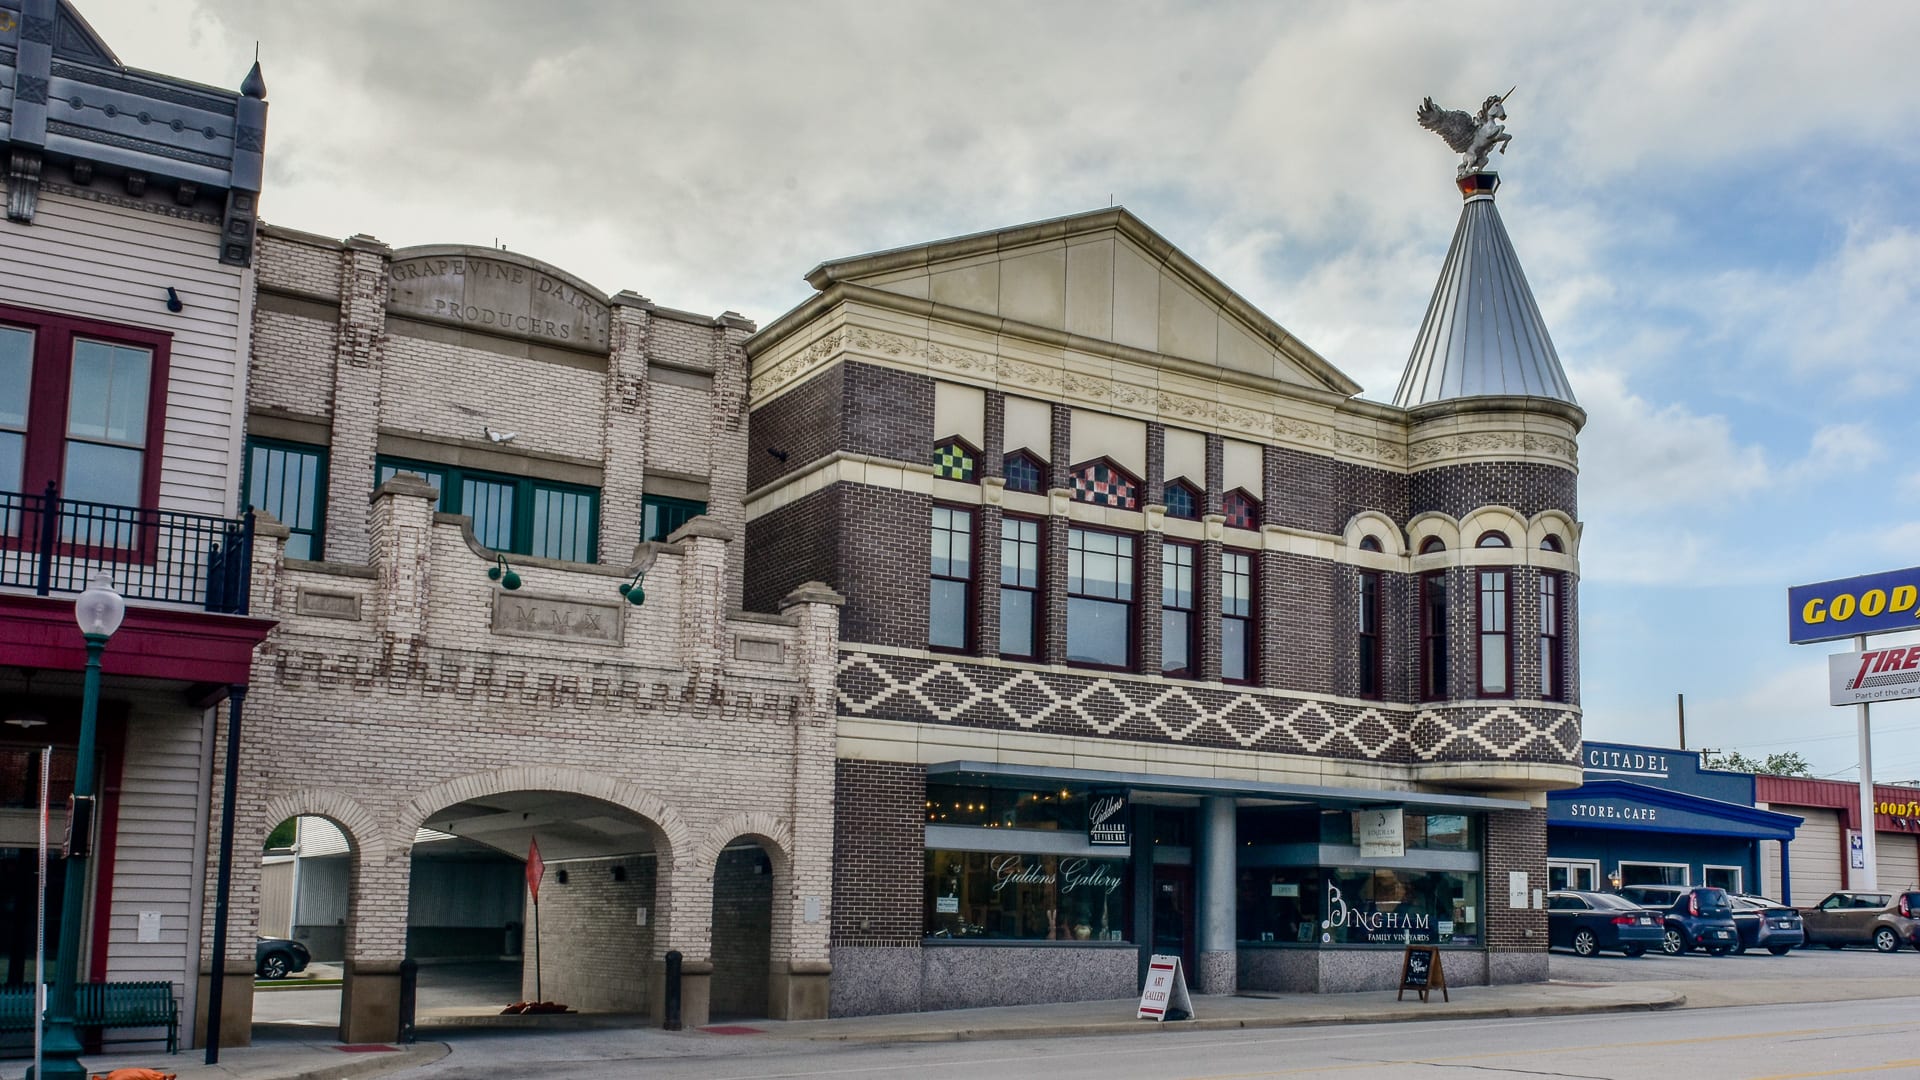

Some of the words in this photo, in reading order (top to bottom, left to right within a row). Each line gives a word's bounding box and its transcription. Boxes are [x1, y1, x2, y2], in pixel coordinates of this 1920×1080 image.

[391, 260, 523, 283] GRAPEVINE
[537, 276, 608, 321] DAIRY
[434, 299, 569, 339] PRODUCERS
[516, 606, 600, 631] MMX
[1802, 584, 1918, 625] GOOD
[1852, 646, 1920, 690] TIRE
[1855, 691, 1872, 699] Part
[1885, 689, 1898, 697] the
[1901, 687, 1915, 695] Car
[1590, 750, 1668, 771] CITADEL
[1089, 796, 1123, 835] Giddens
[1571, 804, 1614, 818] STORE
[1624, 807, 1656, 820] CAFE
[991, 855, 1056, 892] Giddens
[1060, 856, 1121, 895] Gallery
[1321, 879, 1430, 931] BINGHAM
[1368, 933, 1391, 941] FAMILY
[1393, 933, 1430, 941] VINYARDS
[1145, 990, 1166, 1002] GALLERY
[1154, 976, 1165, 987] ART
